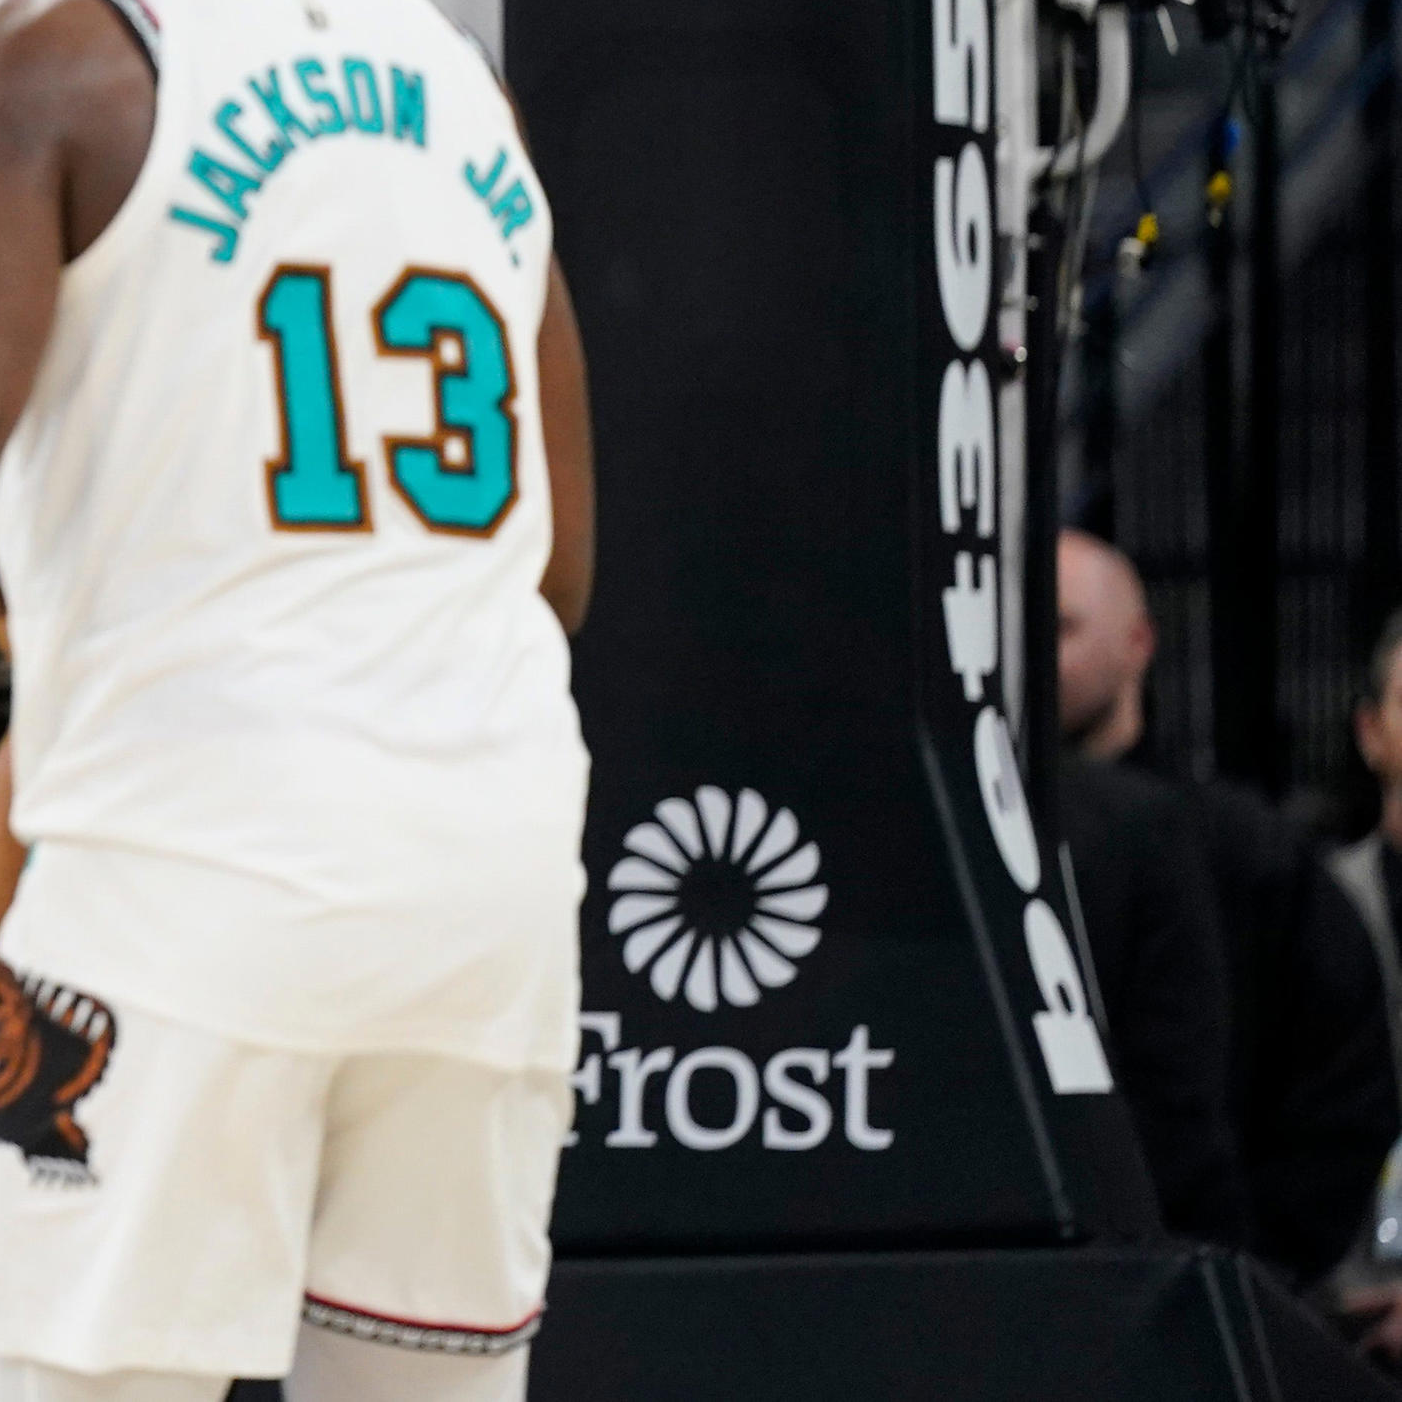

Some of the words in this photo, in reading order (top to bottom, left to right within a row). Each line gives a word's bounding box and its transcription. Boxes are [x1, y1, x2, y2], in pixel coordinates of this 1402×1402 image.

[168, 55, 428, 264] JACKSON
[461, 144, 535, 270] JR.
[255, 261, 521, 539] 13
